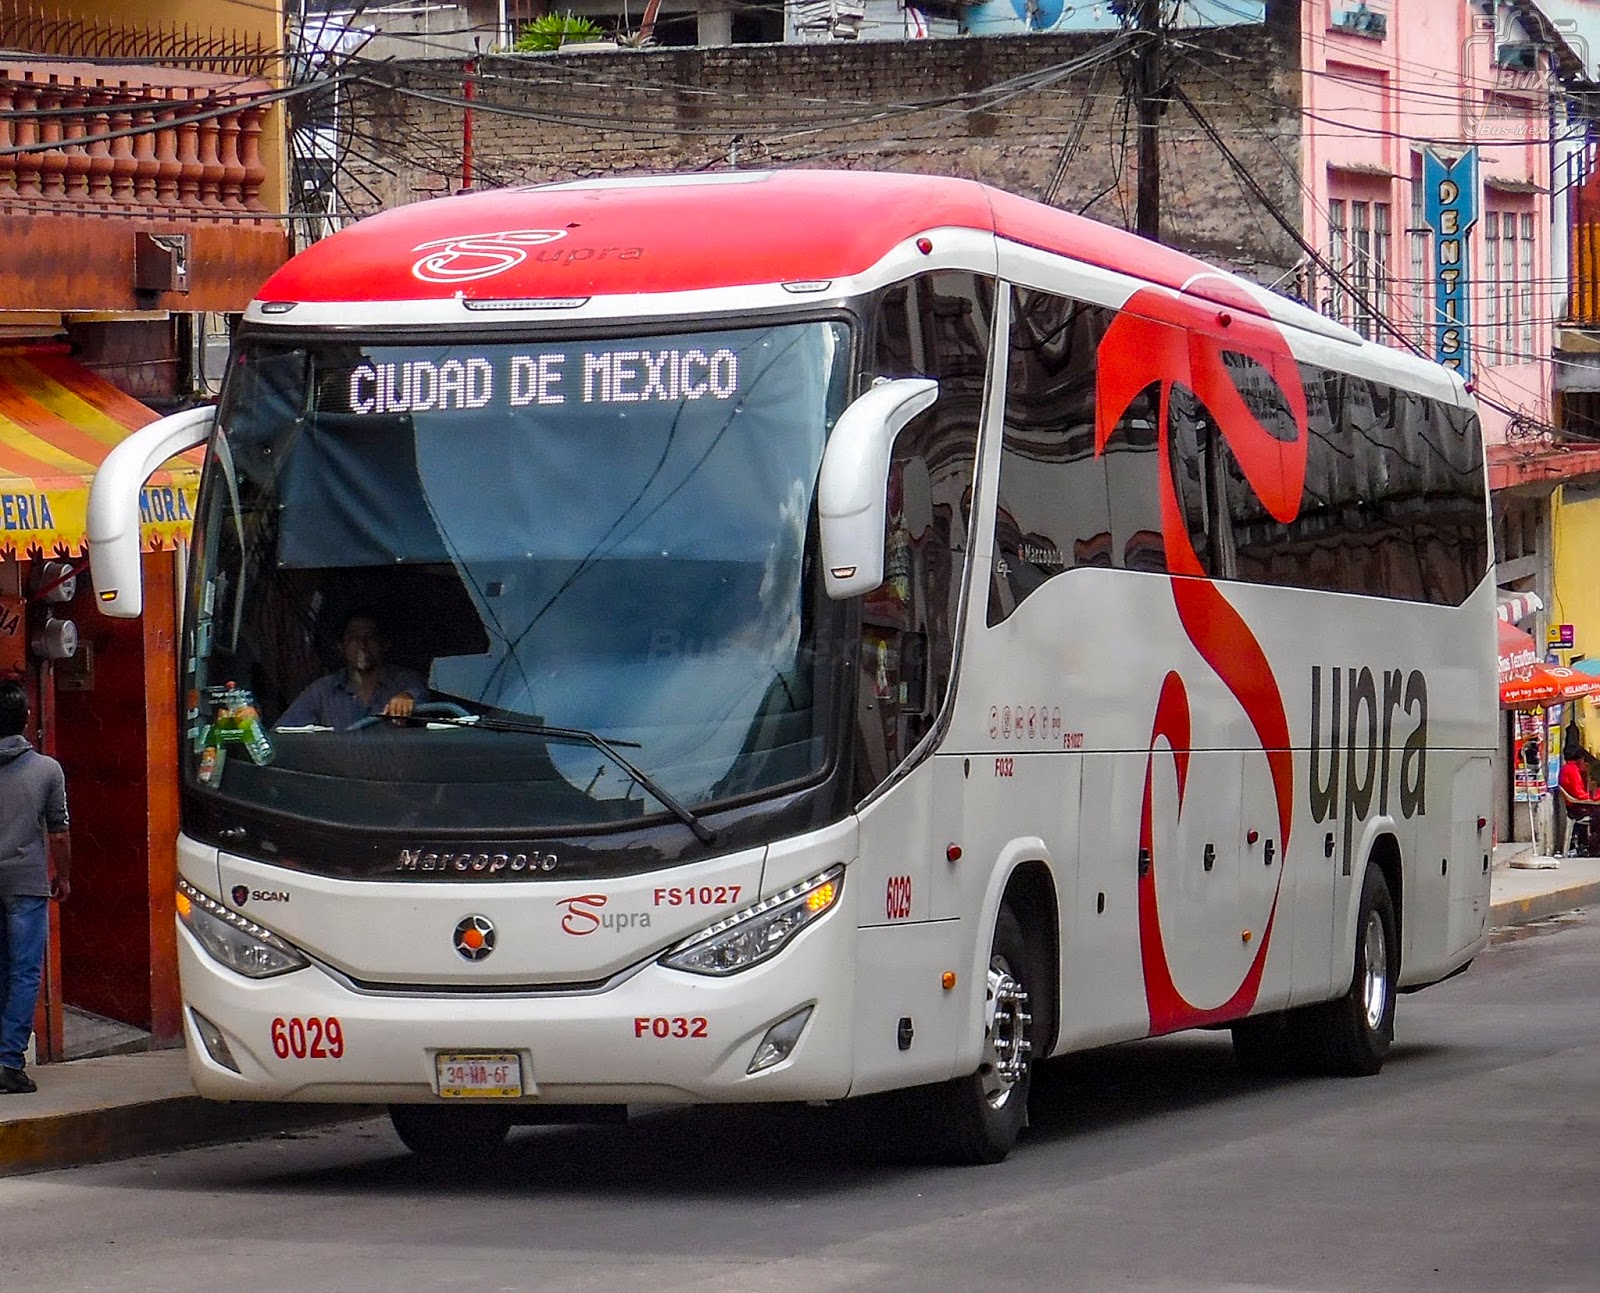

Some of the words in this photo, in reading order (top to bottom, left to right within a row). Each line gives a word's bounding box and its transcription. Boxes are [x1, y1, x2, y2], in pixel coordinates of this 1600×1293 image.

[411, 228, 645, 284] Supra
[348, 357, 494, 415] CIUDAD
[509, 353, 566, 407] DE
[582, 347, 738, 404] MEXICO
[0, 493, 55, 531] ERIA
[1063, 733, 1084, 749] FS1027
[994, 757, 1014, 777] F032
[396, 847, 559, 875] Marcopolo
[252, 891, 290, 903] SCAN
[653, 885, 742, 907] FS1027
[885, 875, 912, 920] 6029
[555, 893, 651, 936] Supra
[270, 1016, 346, 1060] 6029
[634, 1016, 709, 1039] F032
